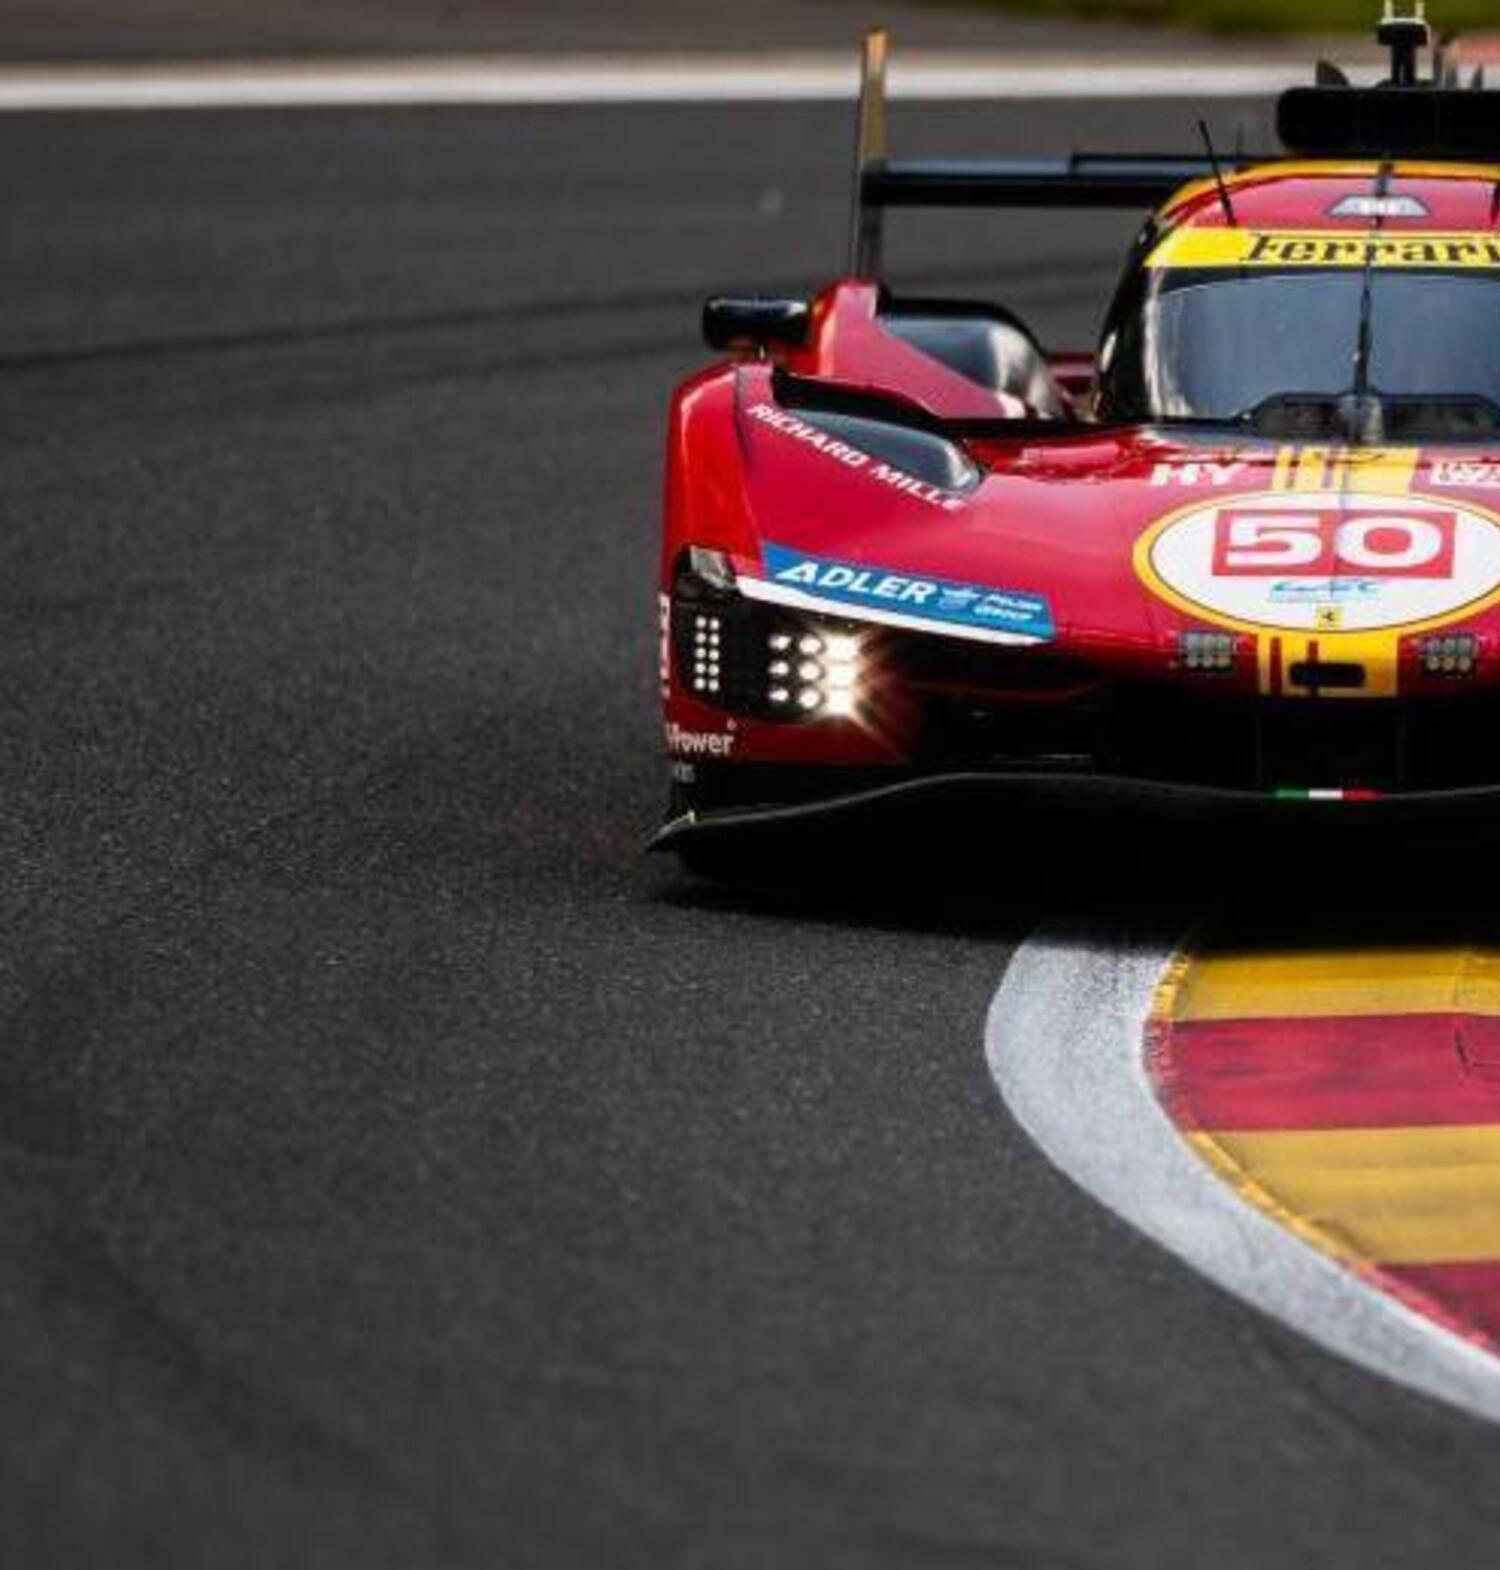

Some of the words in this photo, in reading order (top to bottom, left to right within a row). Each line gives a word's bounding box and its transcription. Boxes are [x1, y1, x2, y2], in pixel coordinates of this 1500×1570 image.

[747, 403, 869, 467] RICHARD
[867, 460, 966, 513] MILLE
[1151, 463, 1247, 486] HY
[1225, 515, 1442, 569] 50
[776, 562, 937, 606] ADLER
